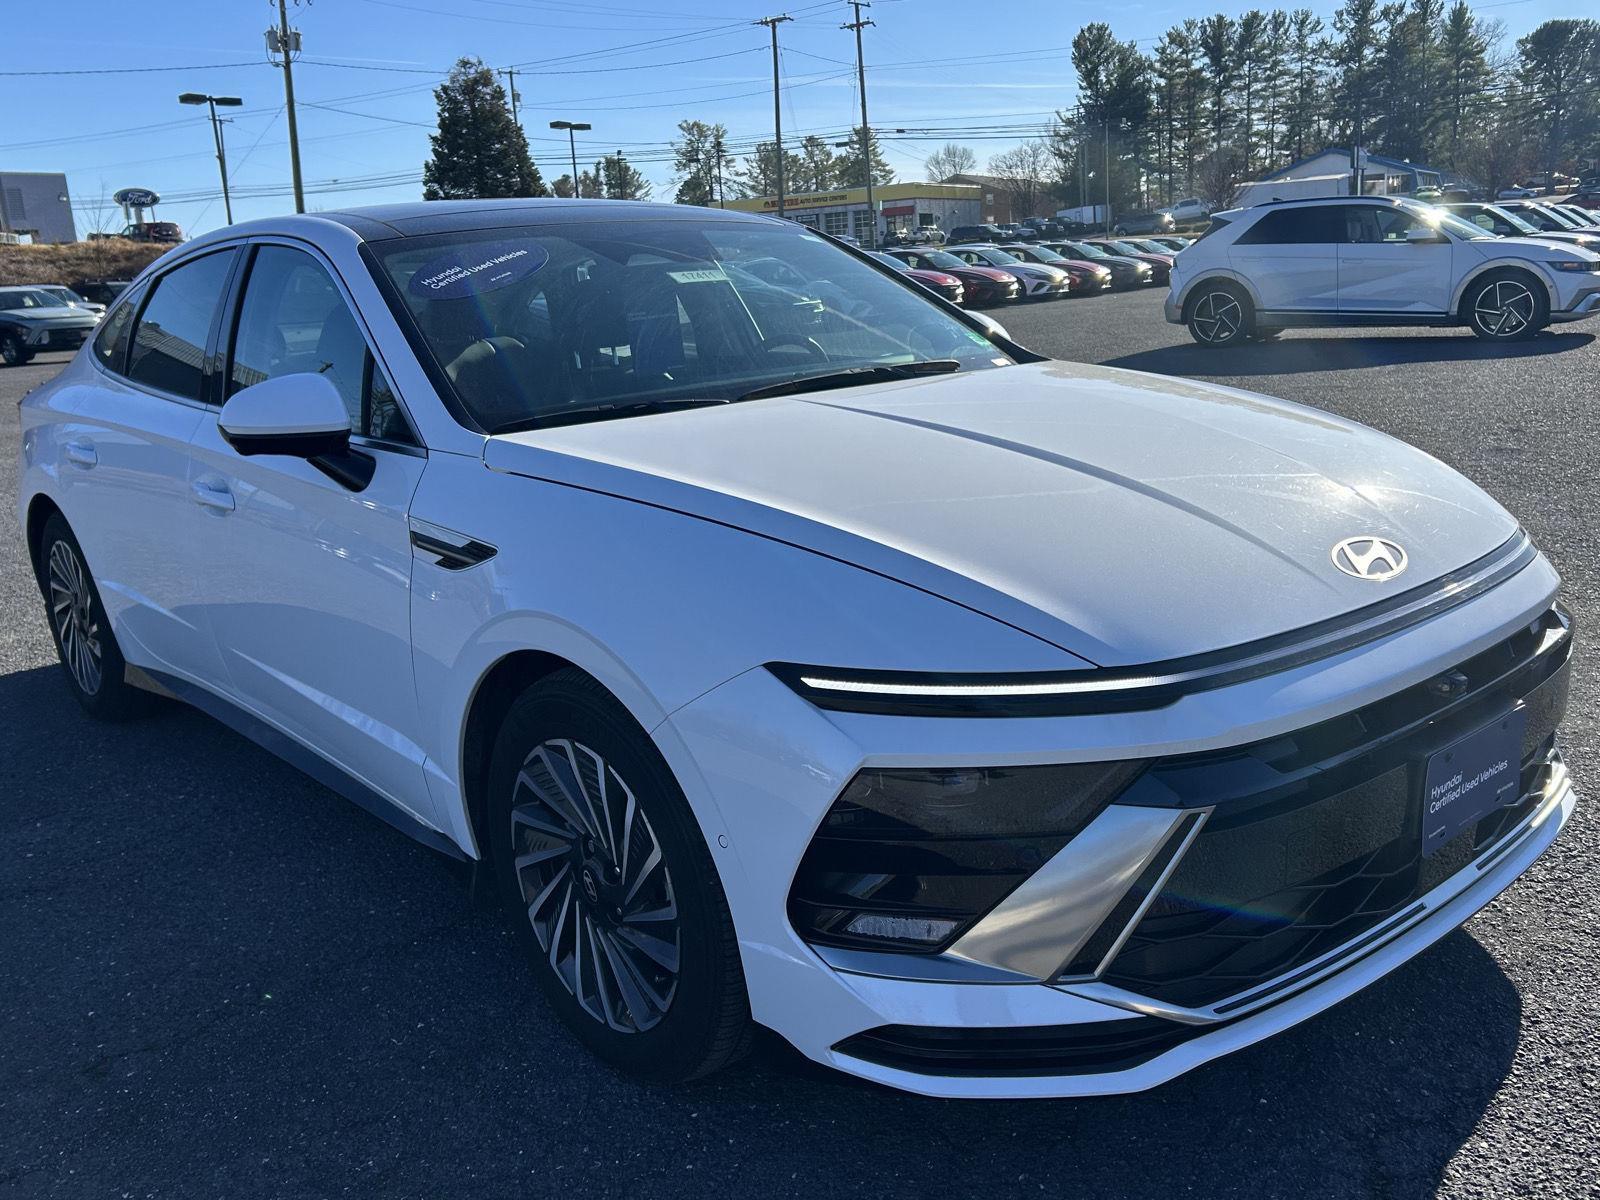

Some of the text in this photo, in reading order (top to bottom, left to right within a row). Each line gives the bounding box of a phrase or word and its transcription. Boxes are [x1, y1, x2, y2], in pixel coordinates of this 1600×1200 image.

[127, 192, 152, 204] Ford
[421, 266, 462, 286] Hyundai
[431, 250, 528, 289] Certified Used Vehicles
[681, 272, 717, 280] 17411
[1430, 787, 1460, 813] Certified
[1461, 774, 1479, 794] Used
[1480, 760, 1508, 782] Vehicles
[1431, 770, 1463, 799] Hyundai
